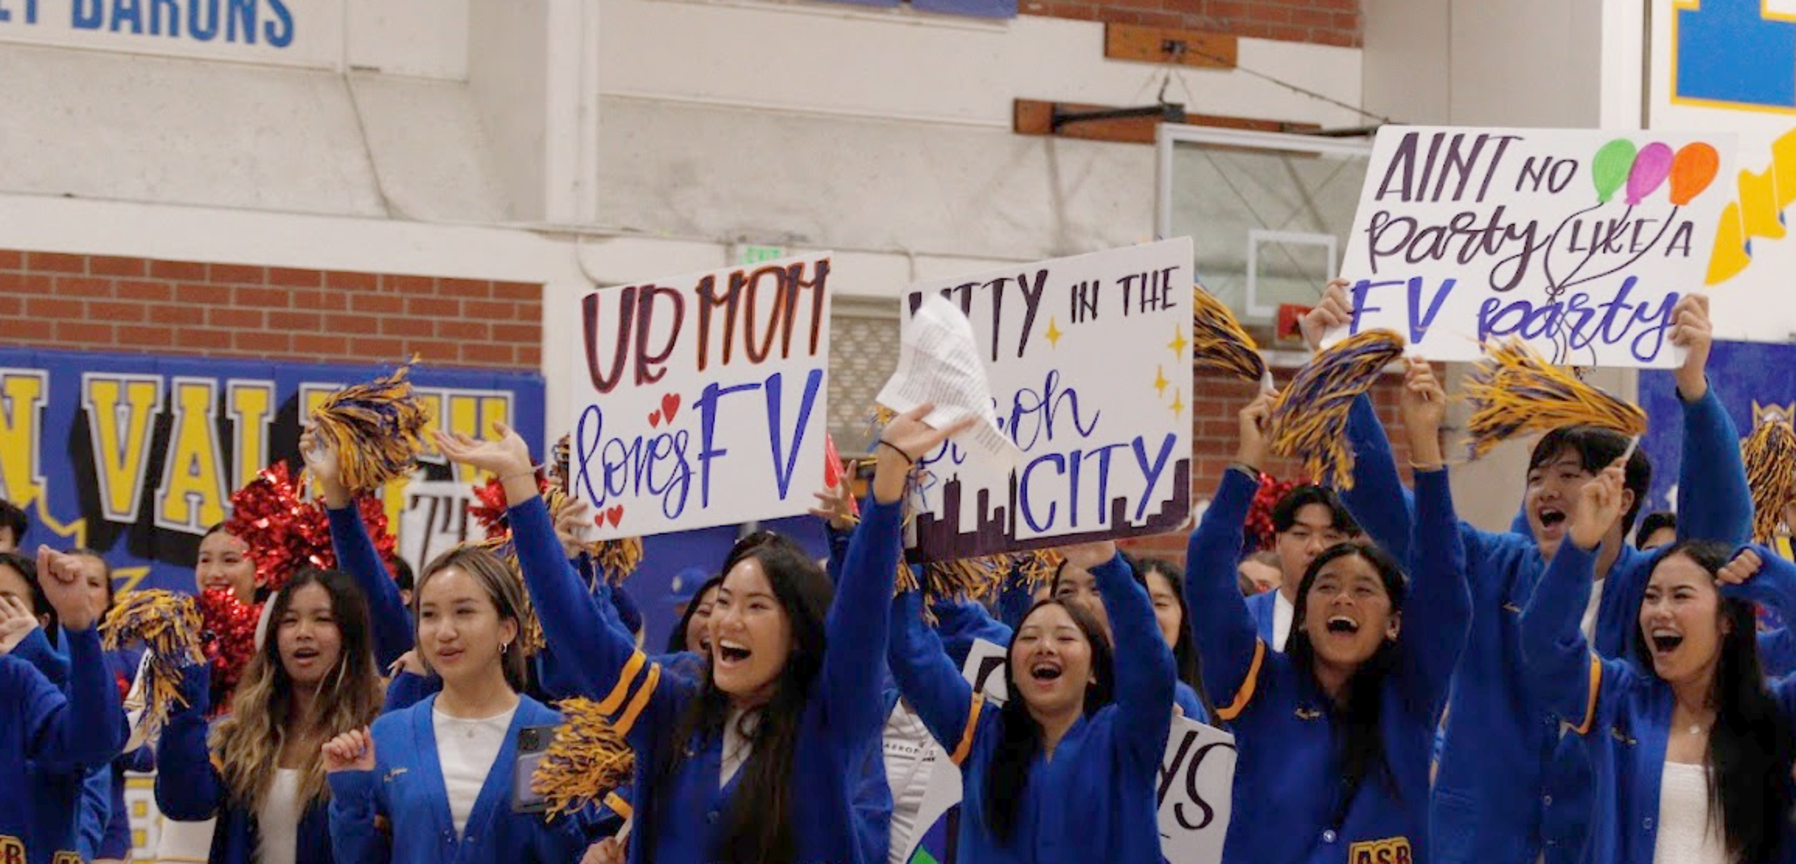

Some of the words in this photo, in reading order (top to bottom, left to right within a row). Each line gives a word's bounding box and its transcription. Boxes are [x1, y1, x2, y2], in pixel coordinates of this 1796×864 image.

[1375, 132, 1524, 203] AINT
[1515, 156, 1578, 194] NO
[1365, 205, 1551, 292] party
[1567, 219, 1658, 254] LIKE
[1665, 221, 1694, 257] A
[582, 284, 685, 394] UR
[695, 257, 830, 372] MOM
[908, 269, 1048, 361] TTY
[1071, 280, 1099, 323] IN
[1116, 265, 1180, 317] THE
[1477, 276, 1680, 363] party
[576, 404, 695, 519] loves
[1020, 433, 1177, 533] CITY
